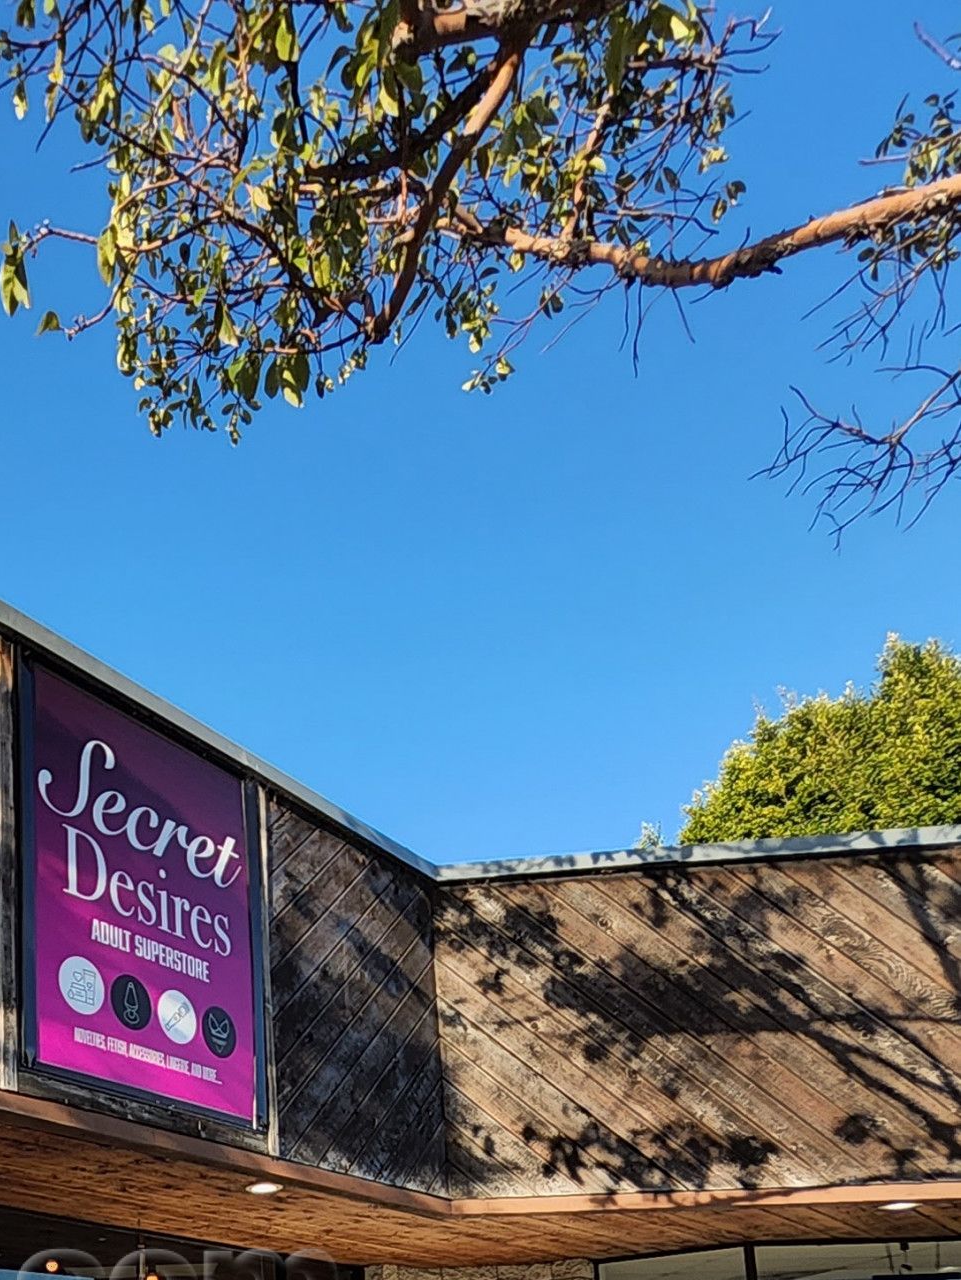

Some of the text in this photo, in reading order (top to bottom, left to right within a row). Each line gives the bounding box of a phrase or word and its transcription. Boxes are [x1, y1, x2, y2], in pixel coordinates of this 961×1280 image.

[37, 739, 244, 888] Secret
[62, 823, 232, 957] Desires
[91, 918, 211, 984] ADULT SUPERSTORE
